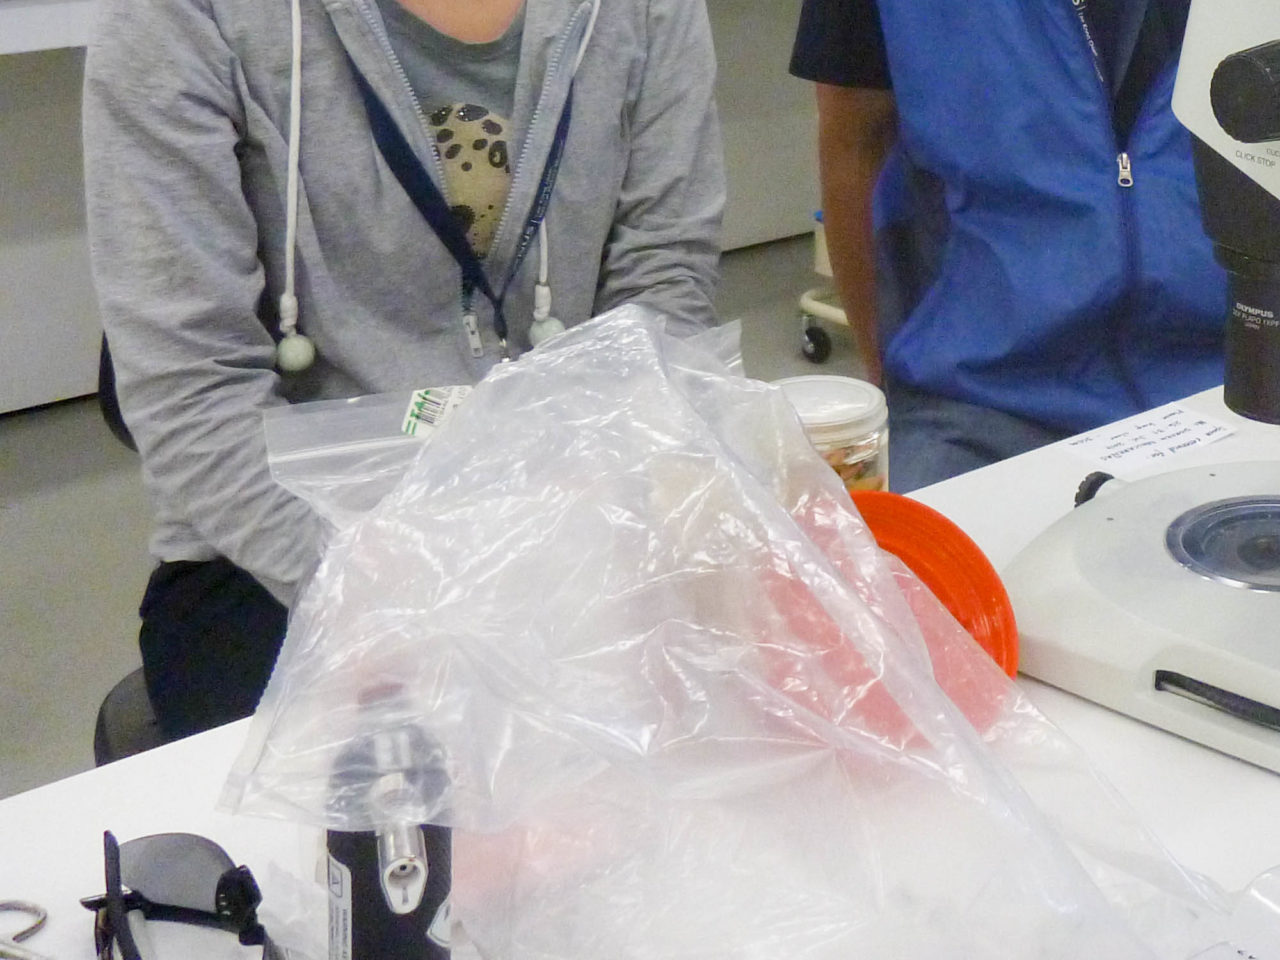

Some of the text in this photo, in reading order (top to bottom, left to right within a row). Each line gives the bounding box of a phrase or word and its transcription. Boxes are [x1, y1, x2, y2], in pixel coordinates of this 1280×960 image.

[1235, 150, 1276, 169] CLICK STOP
[1236, 302, 1274, 319] OLYMPUS
